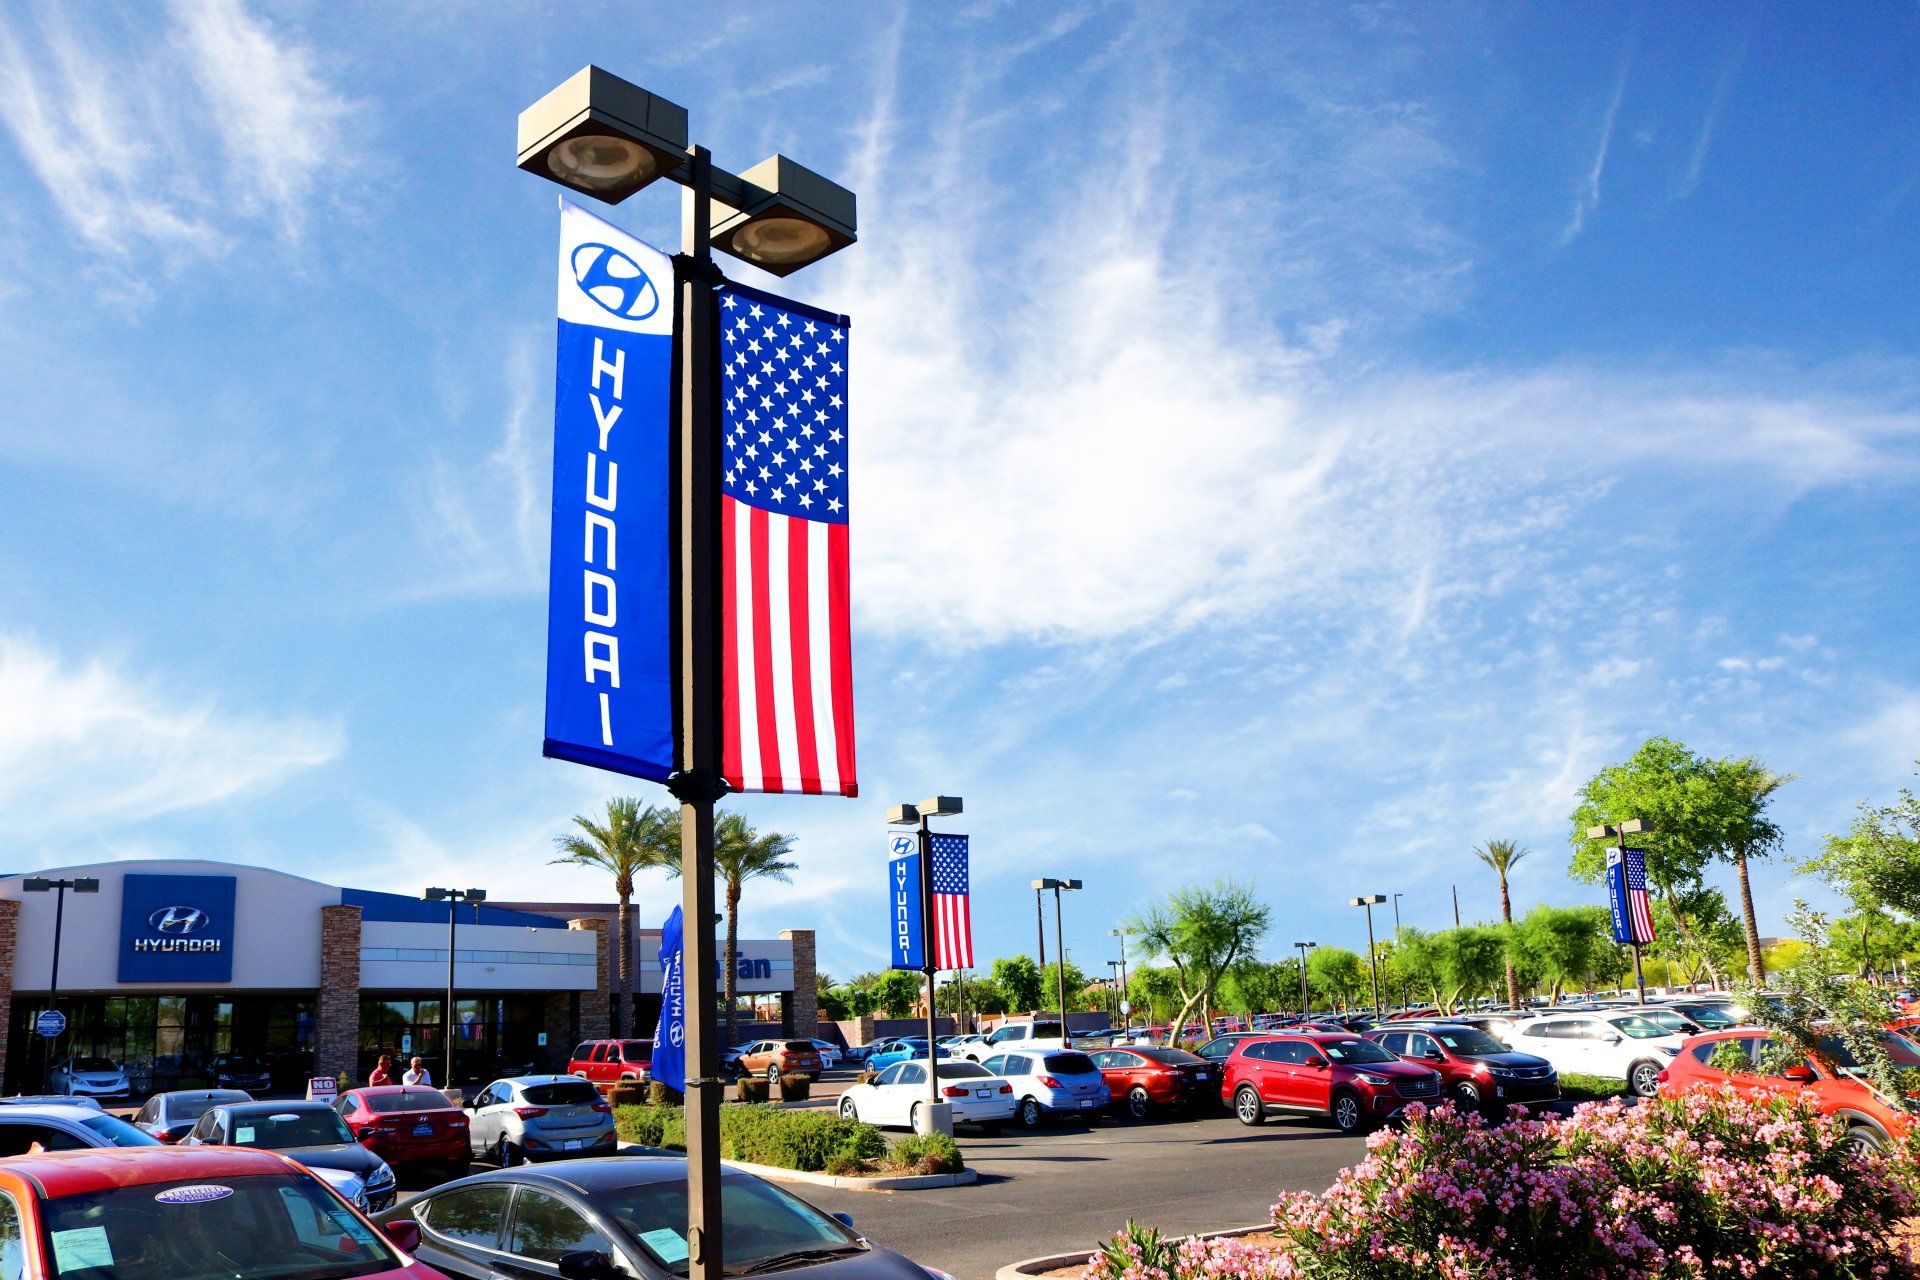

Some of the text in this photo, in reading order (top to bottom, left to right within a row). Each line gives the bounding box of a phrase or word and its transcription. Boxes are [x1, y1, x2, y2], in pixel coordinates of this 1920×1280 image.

[584, 337, 626, 746] HYUNDAI
[896, 862, 910, 964] HYUNDAI
[1610, 868, 1624, 939] HYUNDAI
[135, 939, 221, 952] HYUNDAI
[313, 1081, 334, 1089] NO
